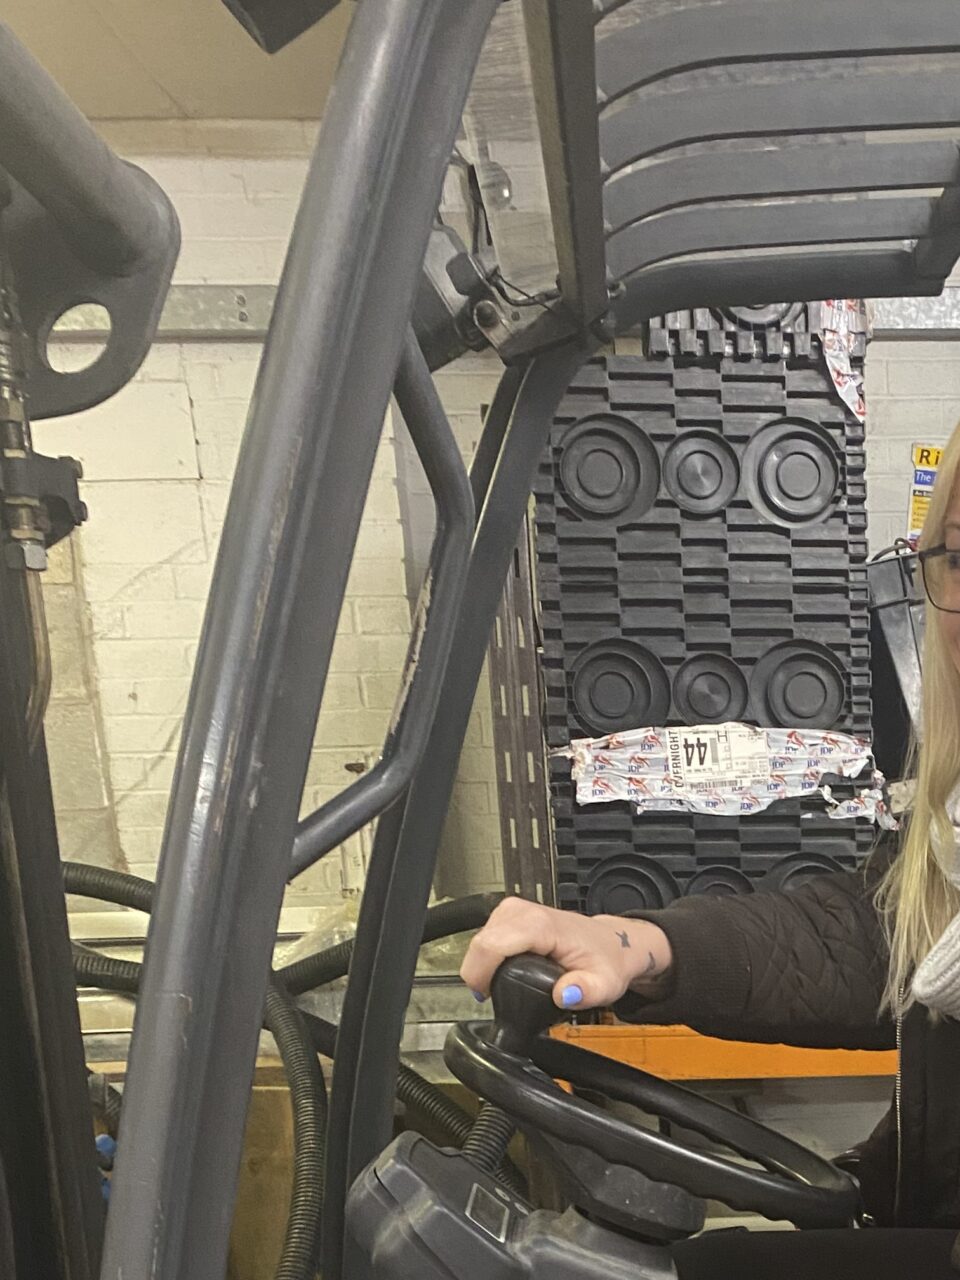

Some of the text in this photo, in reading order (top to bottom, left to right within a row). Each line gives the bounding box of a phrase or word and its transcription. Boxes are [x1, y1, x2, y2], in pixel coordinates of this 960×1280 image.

[920, 449, 940, 465] Ri
[917, 471, 931, 482] The
[683, 737, 707, 766] 44
